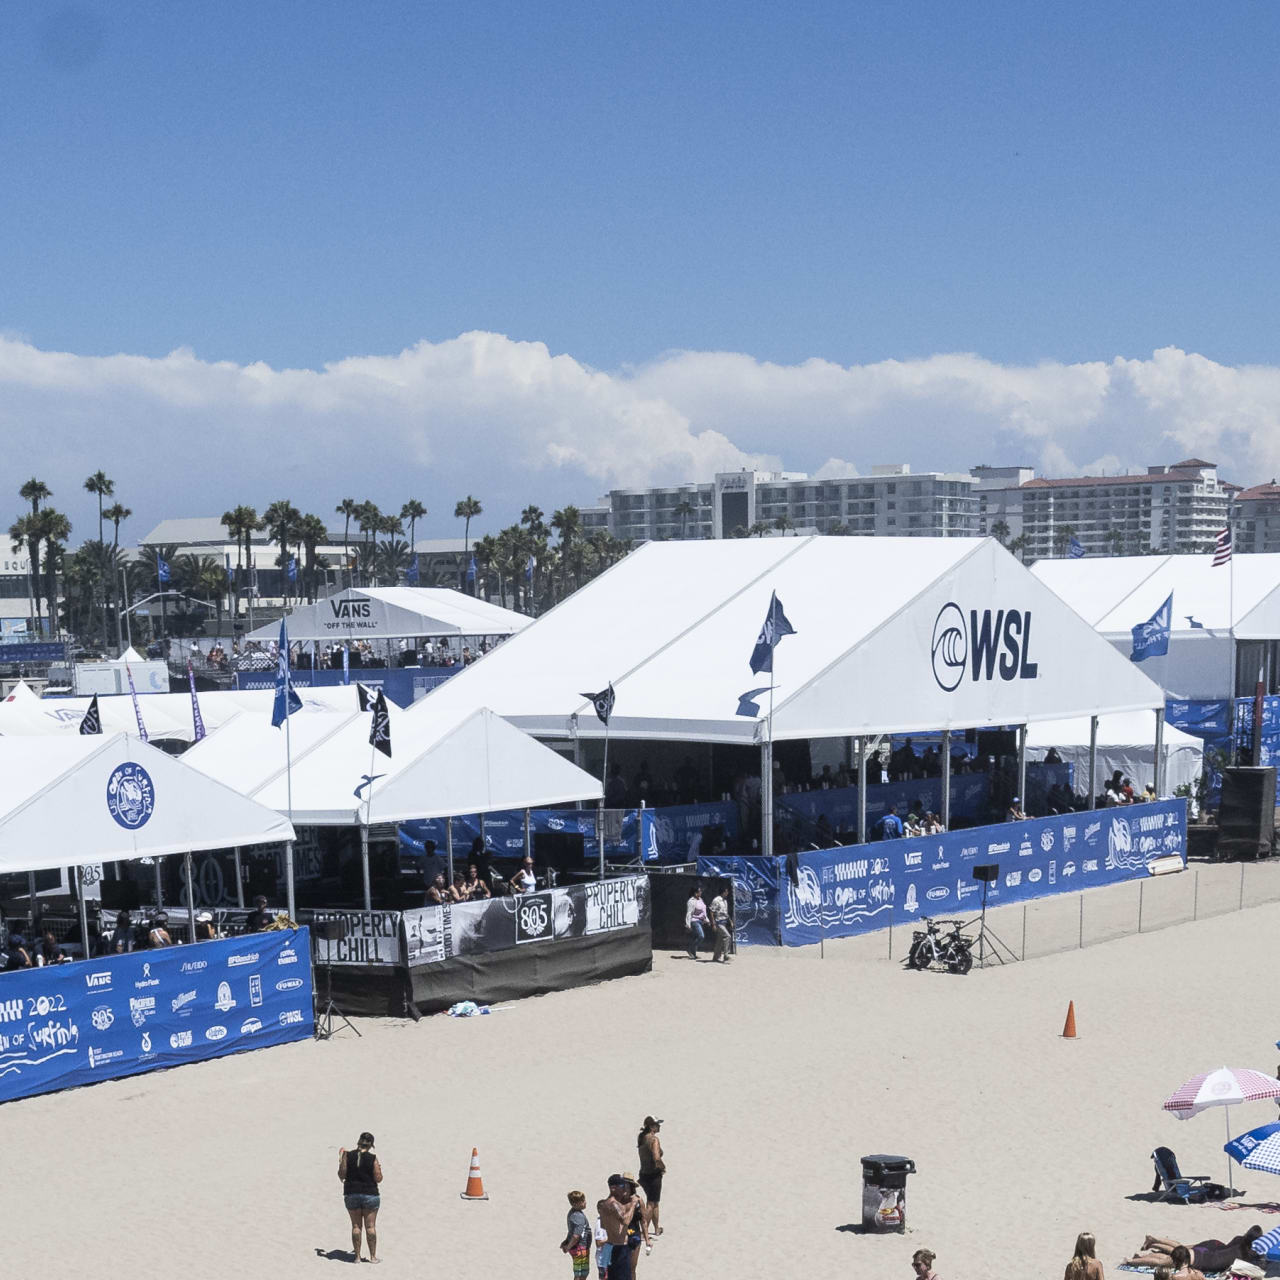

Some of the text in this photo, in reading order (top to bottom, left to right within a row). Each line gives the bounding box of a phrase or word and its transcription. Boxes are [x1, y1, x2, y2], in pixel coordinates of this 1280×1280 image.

[330, 598, 370, 618] VANS
[970, 609, 1039, 682] WSL
[870, 858, 889, 874] 2022
[904, 852, 923, 866] VANS
[586, 877, 638, 906] PROPERLY
[521, 903, 548, 929] 805
[599, 905, 628, 928] CHILL
[336, 937, 385, 963] CHILL
[86, 971, 112, 987] VANS
[27, 994, 67, 1016] 2022
[91, 1009, 115, 1027] 805
[286, 1010, 304, 1024] WSL
[12, 1034, 24, 1045] OF
